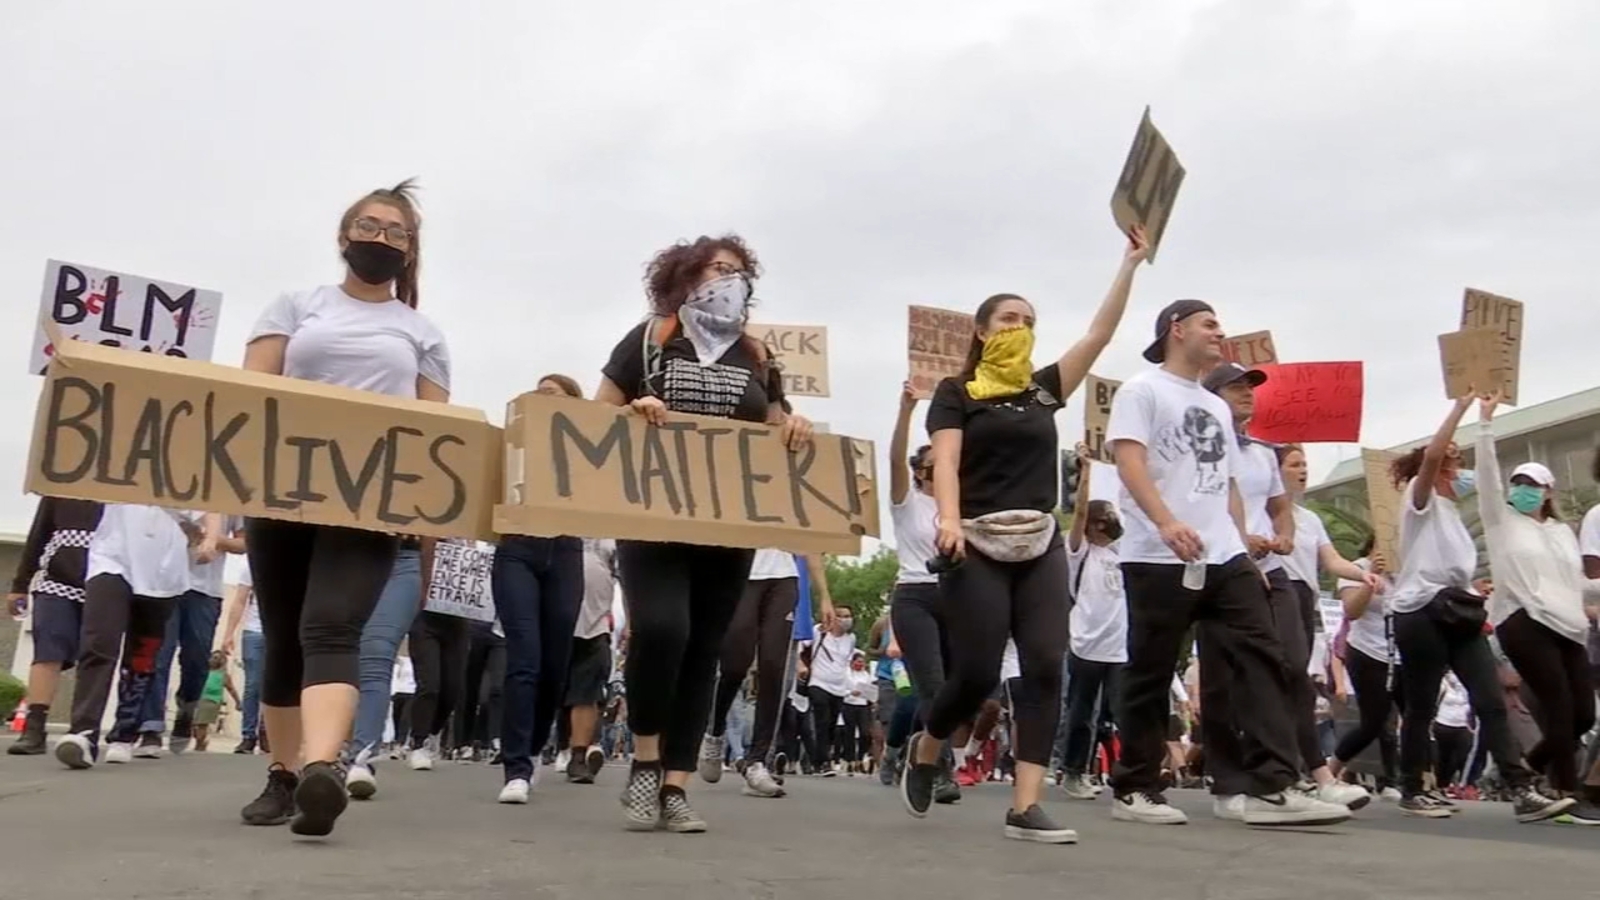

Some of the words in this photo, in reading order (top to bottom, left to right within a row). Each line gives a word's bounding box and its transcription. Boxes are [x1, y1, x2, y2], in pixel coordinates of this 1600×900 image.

[52, 265, 196, 346] BLM
[763, 329, 821, 355] ACK
[780, 374, 821, 393] TER
[41, 377, 256, 504] BLACK
[263, 397, 466, 526] LIVES
[551, 411, 865, 535] MATTER!
[435, 544, 462, 559] ERE
[434, 570, 467, 591] ENCE
[471, 578, 485, 595] IS
[429, 585, 486, 608] ETRAYAL
